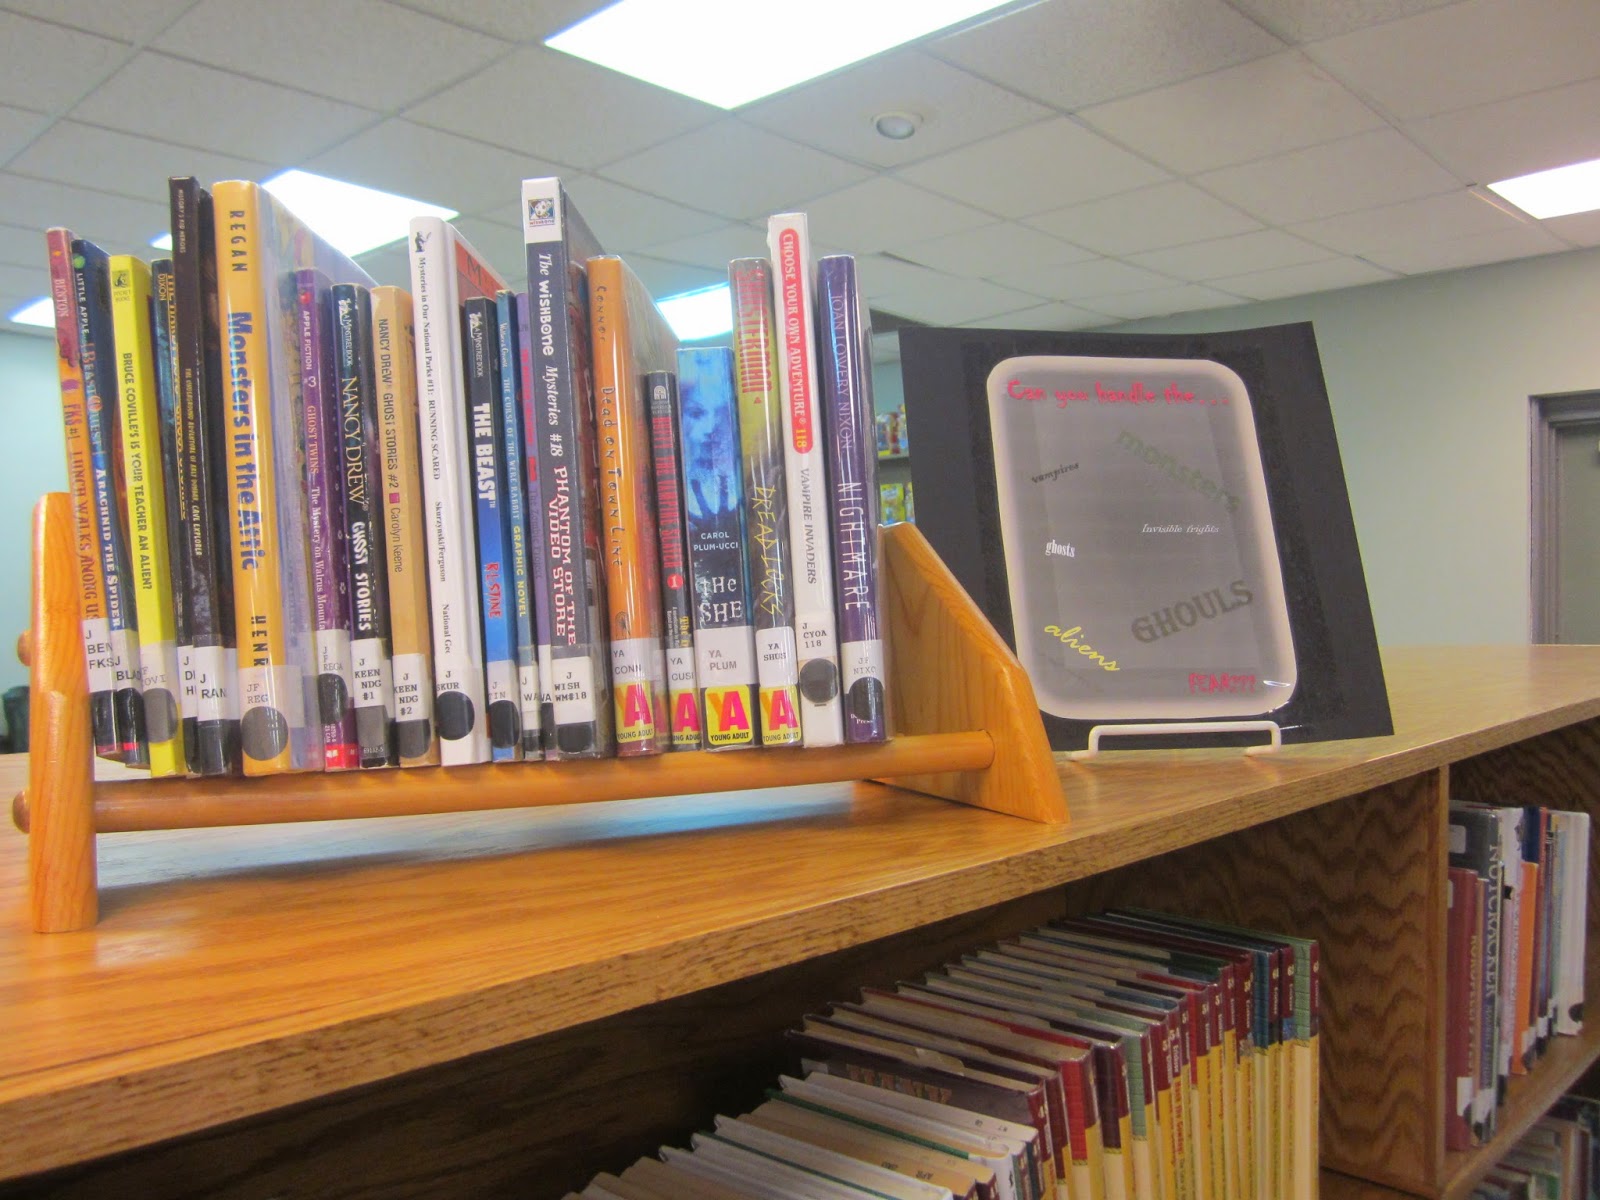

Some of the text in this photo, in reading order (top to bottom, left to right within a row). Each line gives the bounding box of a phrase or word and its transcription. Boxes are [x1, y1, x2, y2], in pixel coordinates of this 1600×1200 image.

[230, 210, 248, 273] REGAN
[539, 254, 552, 276] The
[783, 233, 795, 281] CHOOSE
[158, 273, 167, 301] DIXON
[419, 257, 428, 293] Mysteries
[54, 279, 70, 318] BENTON
[76, 272, 89, 334] LITTLE APPLE
[421, 304, 430, 320] Our
[787, 282, 798, 316] YOUR
[303, 309, 313, 371] APPLE FICTION
[423, 322, 432, 355] National
[789, 317, 800, 345] OWN
[425, 356, 434, 379] Parks
[832, 295, 844, 331] JOAN
[839, 401, 853, 450] NIXON
[543, 365, 560, 426] Mysteries
[1006, 379, 1156, 409] Can you handle
[308, 405, 318, 440] GHOST
[428, 399, 437, 442] RUNNING
[228, 311, 266, 571] Monsters in the Attic
[379, 318, 404, 573] NANCY DREW GHOST STORIES #2 Carolyn Keene
[474, 402, 496, 501] THE BEAST
[550, 434, 563, 457] #18
[796, 428, 807, 449] 118
[72, 451, 87, 497] LUNCH
[123, 352, 152, 591] BRUCE COVILLE'S IS YOUR TEACHER AN ALIEN?
[431, 444, 440, 481] SCARED
[1030, 460, 1081, 484] vampires
[96, 468, 111, 541] ARACHNID
[311, 486, 320, 505] The
[343, 375, 372, 631] NANCY DREW GHOST STORIES
[503, 377, 526, 618] THE CURSE OF THE GRAPHIC NOVEL
[657, 478, 680, 526] VAMPIRE
[76, 500, 91, 551] WALKS
[312, 507, 322, 545] Mystery
[555, 466, 571, 564] PHANTOM
[801, 468, 816, 585] VAMPIRE INVADERS
[1141, 523, 1183, 534] Invisible
[661, 528, 683, 569] SLAYER
[700, 531, 730, 540] CAROL
[838, 481, 870, 611] NIGHTMARE
[1045, 538, 1076, 558] ghosts
[105, 543, 115, 572] THE
[314, 546, 323, 559] on
[78, 554, 96, 600] AMONG
[315, 559, 324, 593] Walrus
[549, 498, 565, 637] VIDEO STORE
[564, 571, 573, 595] OF
[108, 575, 122, 628] SPIDER
[487, 582, 502, 619] STINE
[698, 600, 743, 624] SHE
[1130, 578, 1255, 644] GHOULS
[85, 630, 92, 639] J
[442, 603, 451, 638] National
[567, 601, 576, 645] THE
[802, 622, 808, 630] J
[803, 630, 827, 639] CYOA
[613, 649, 625, 658] YA
[708, 649, 722, 658] YA
[768, 643, 780, 651] YA
[804, 640, 822, 649] 118
[1043, 624, 1121, 672] aliens
[354, 668, 381, 679] KEEN
[359, 657, 366, 667] J
[445, 670, 452, 679] J
[567, 671, 573, 680] J
[671, 657, 683, 665] YA
[709, 660, 737, 671] PLUM
[200, 673, 206, 684] J
[361, 680, 382, 689] NDG
[402, 673, 409, 681] J
[522, 676, 527, 686] J
[554, 681, 580, 691] WISH
[201, 688, 227, 699] RAN
[362, 691, 376, 701] #1
[398, 695, 419, 705] NDG
[400, 706, 413, 716] #2
[707, 690, 750, 732] YA
[710, 731, 750, 742] YOUNG ADULT
